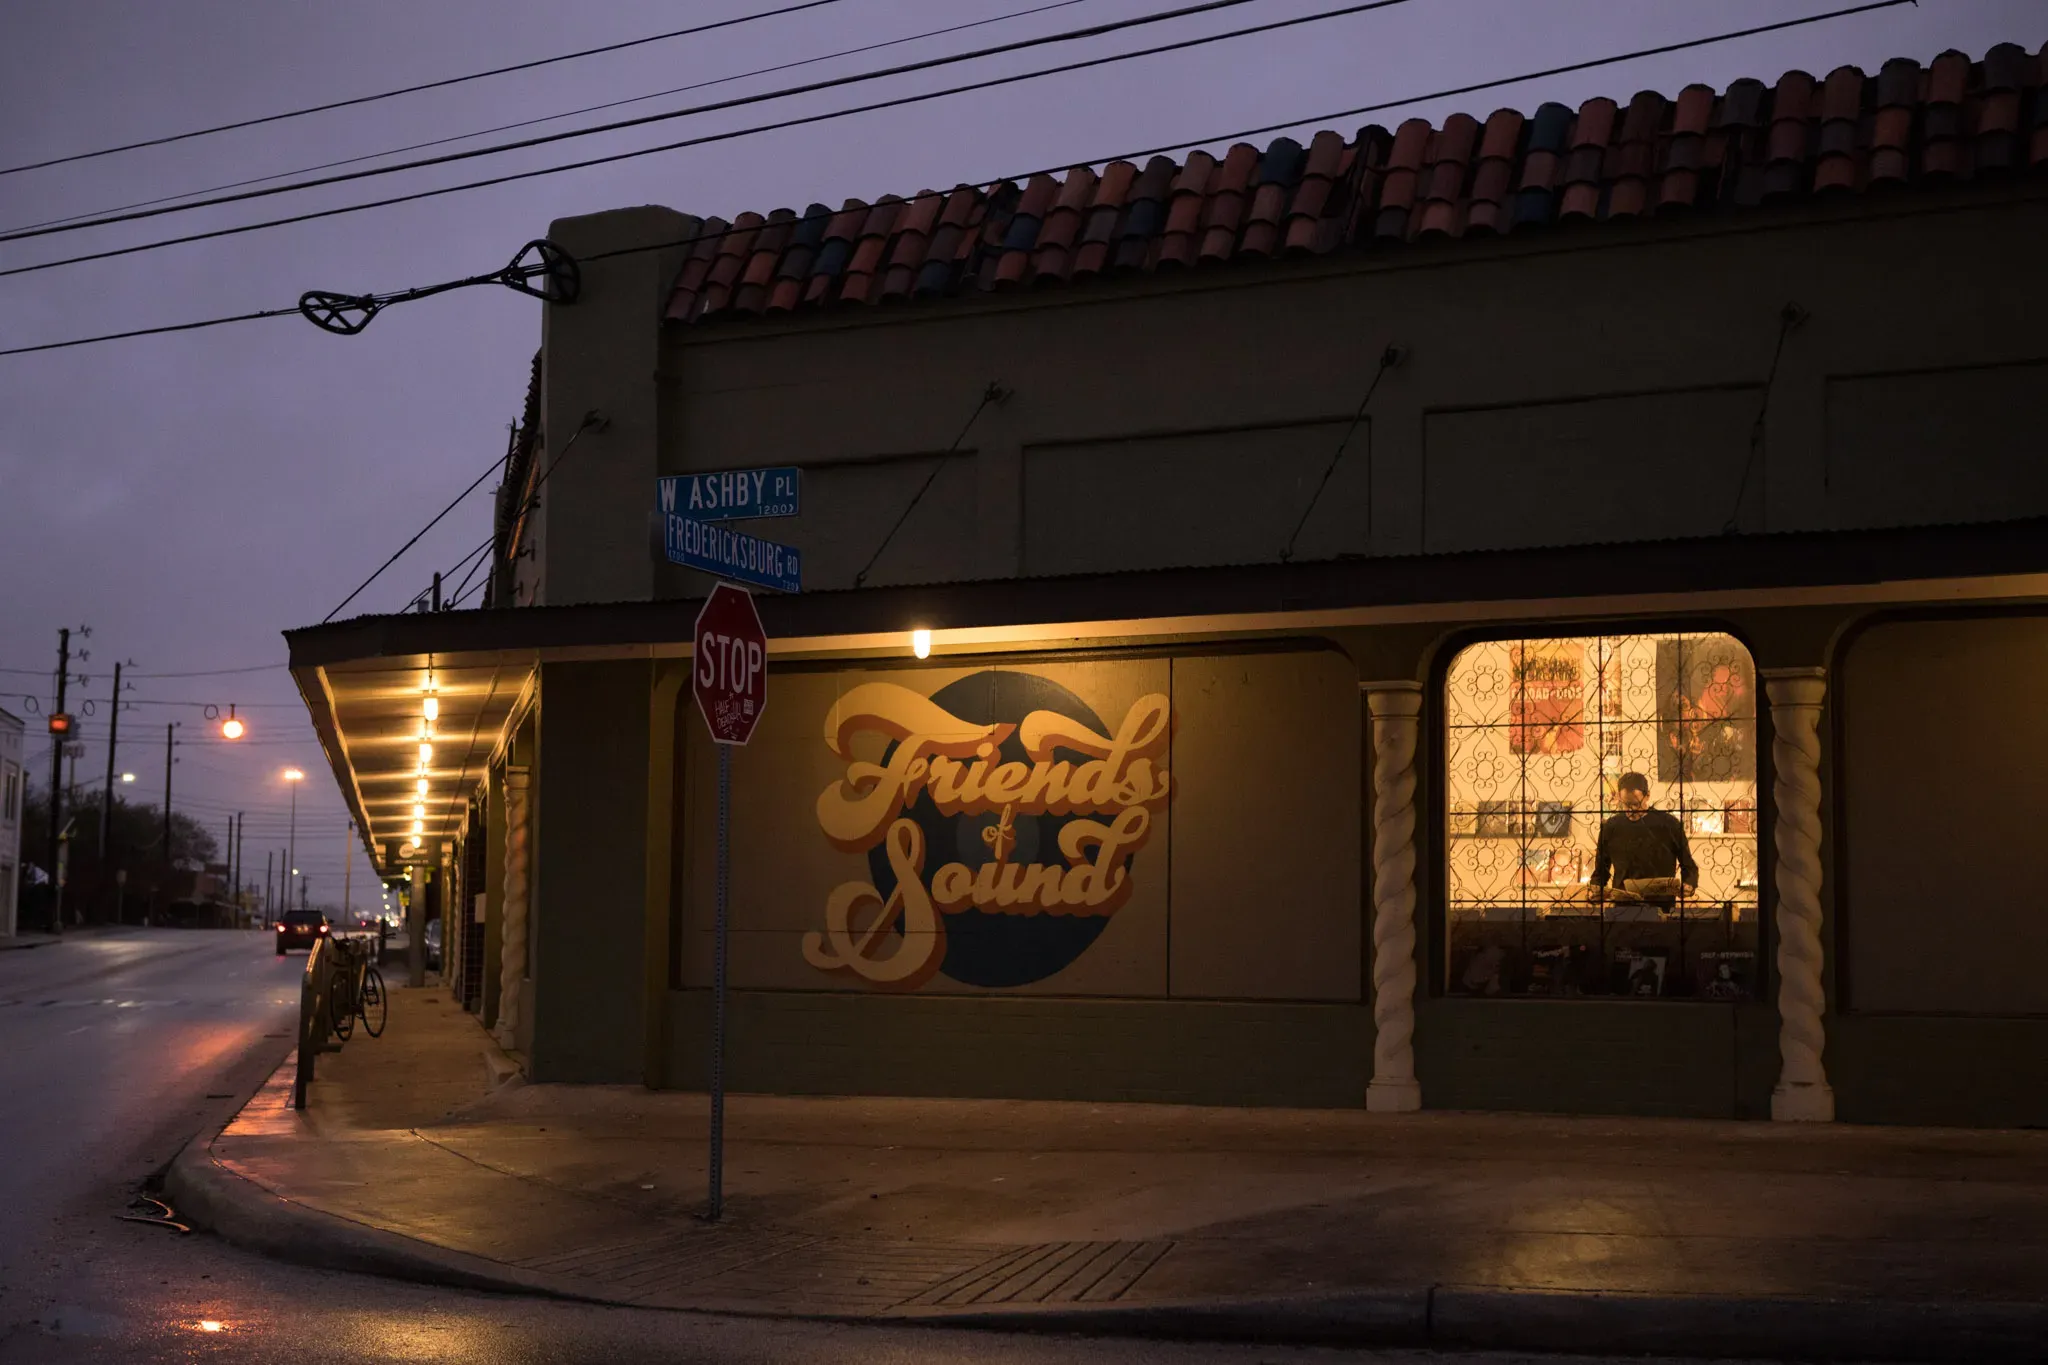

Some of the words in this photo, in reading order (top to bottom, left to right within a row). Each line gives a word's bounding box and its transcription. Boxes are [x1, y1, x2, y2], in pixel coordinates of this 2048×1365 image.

[660, 479, 677, 512] W
[688, 471, 767, 510] ASHBY
[775, 476, 794, 497] PL
[668, 513, 783, 578] FREDERICKSBURG
[787, 555, 798, 576] RD
[699, 631, 762, 695] STOP
[816, 682, 1173, 846] Friends
[981, 803, 1016, 860] of
[801, 805, 1150, 984] Sound
